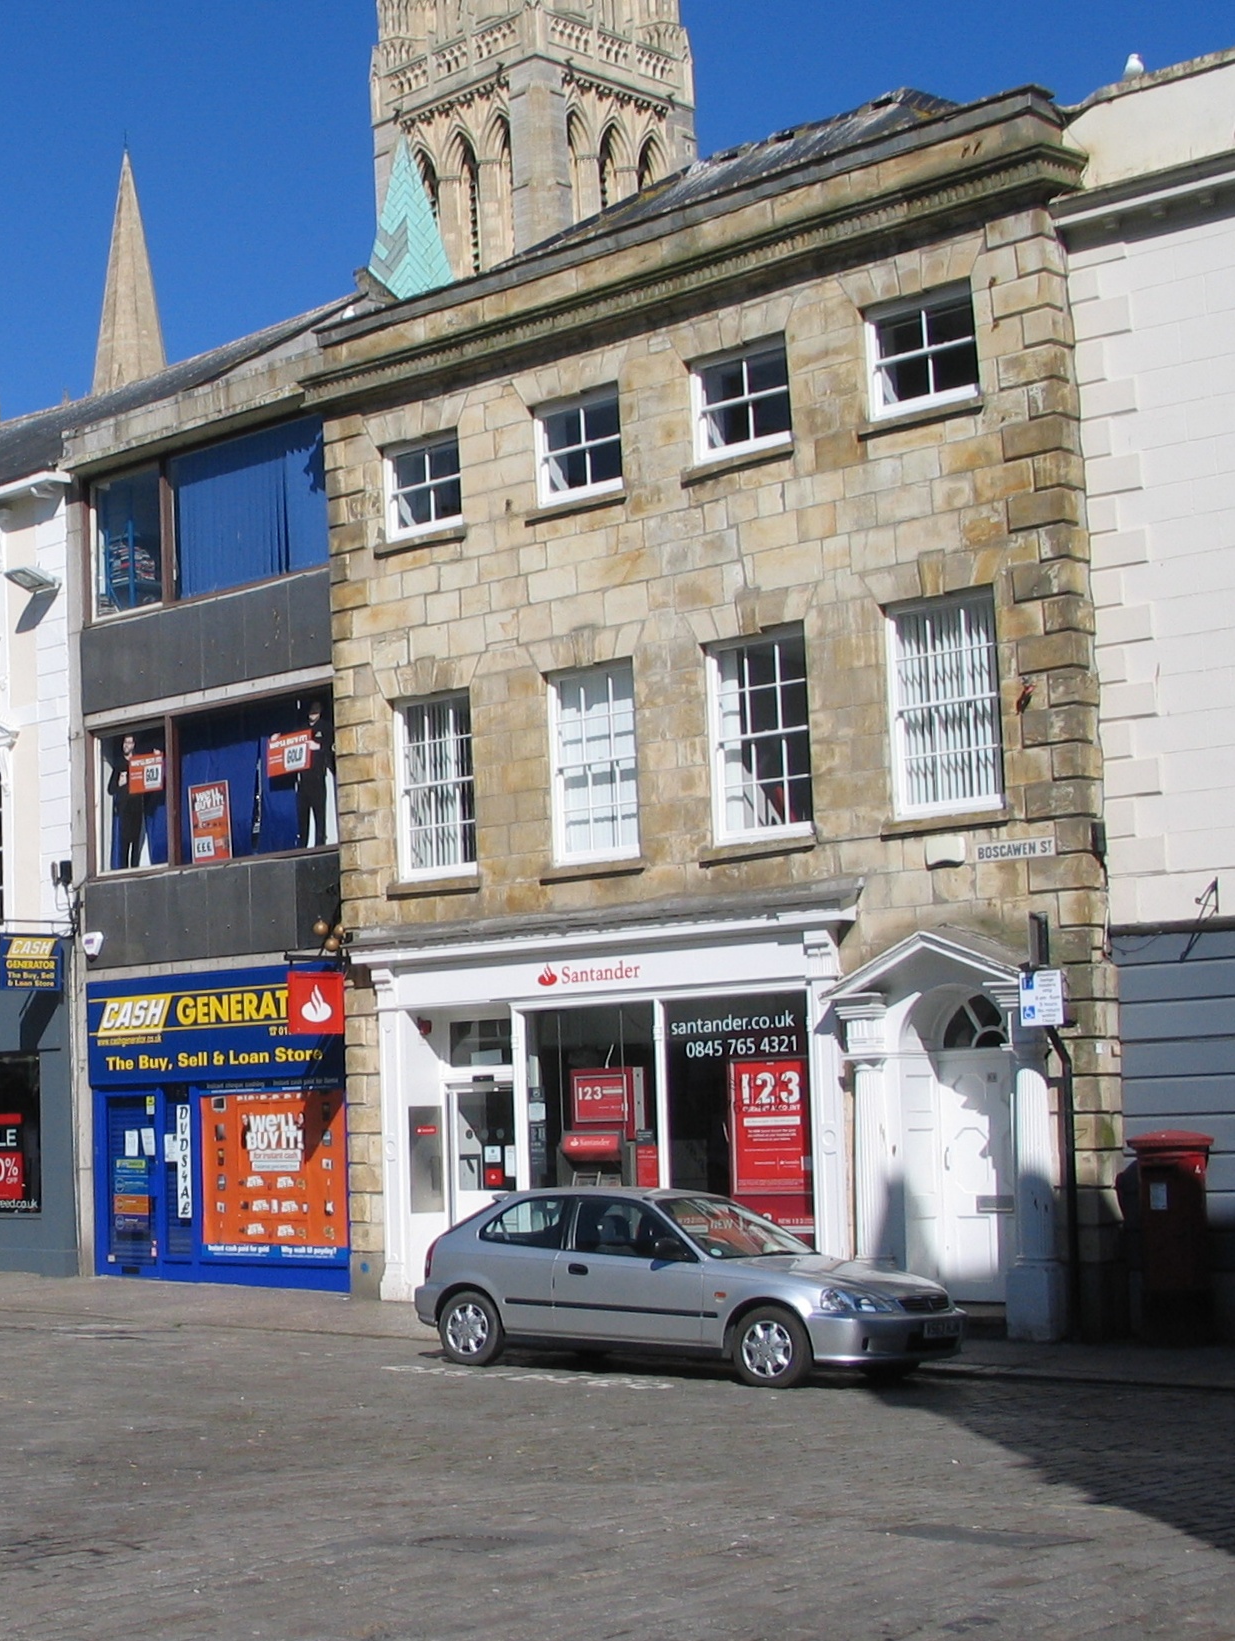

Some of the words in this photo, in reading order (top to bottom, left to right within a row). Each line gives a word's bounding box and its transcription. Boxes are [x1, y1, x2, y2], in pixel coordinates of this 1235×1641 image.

[287, 747, 303, 764] GOLD
[146, 767, 159, 782] GOLD
[977, 841, 1036, 860] BOSCAWEN
[11, 940, 52, 955] CASH
[6, 960, 55, 970] GENERATOR
[561, 961, 641, 985] Santander
[102, 998, 166, 1029] CASH
[176, 990, 288, 1025] GENERAT
[671, 1010, 795, 1036] santander.co.uk
[686, 1040, 723, 1059] 0845
[728, 1037, 756, 1056] 765
[760, 1035, 798, 1054] 4321
[106, 1056, 134, 1072] The
[139, 1054, 173, 1072] Buy,
[178, 1052, 208, 1067] Sell
[213, 1050, 225, 1066] &
[229, 1050, 270, 1065] Loan
[274, 1046, 323, 1063] Store
[578, 1086, 603, 1100] 123
[246, 1130, 279, 1150] BUY
[579, 1138, 610, 1146] Santander
